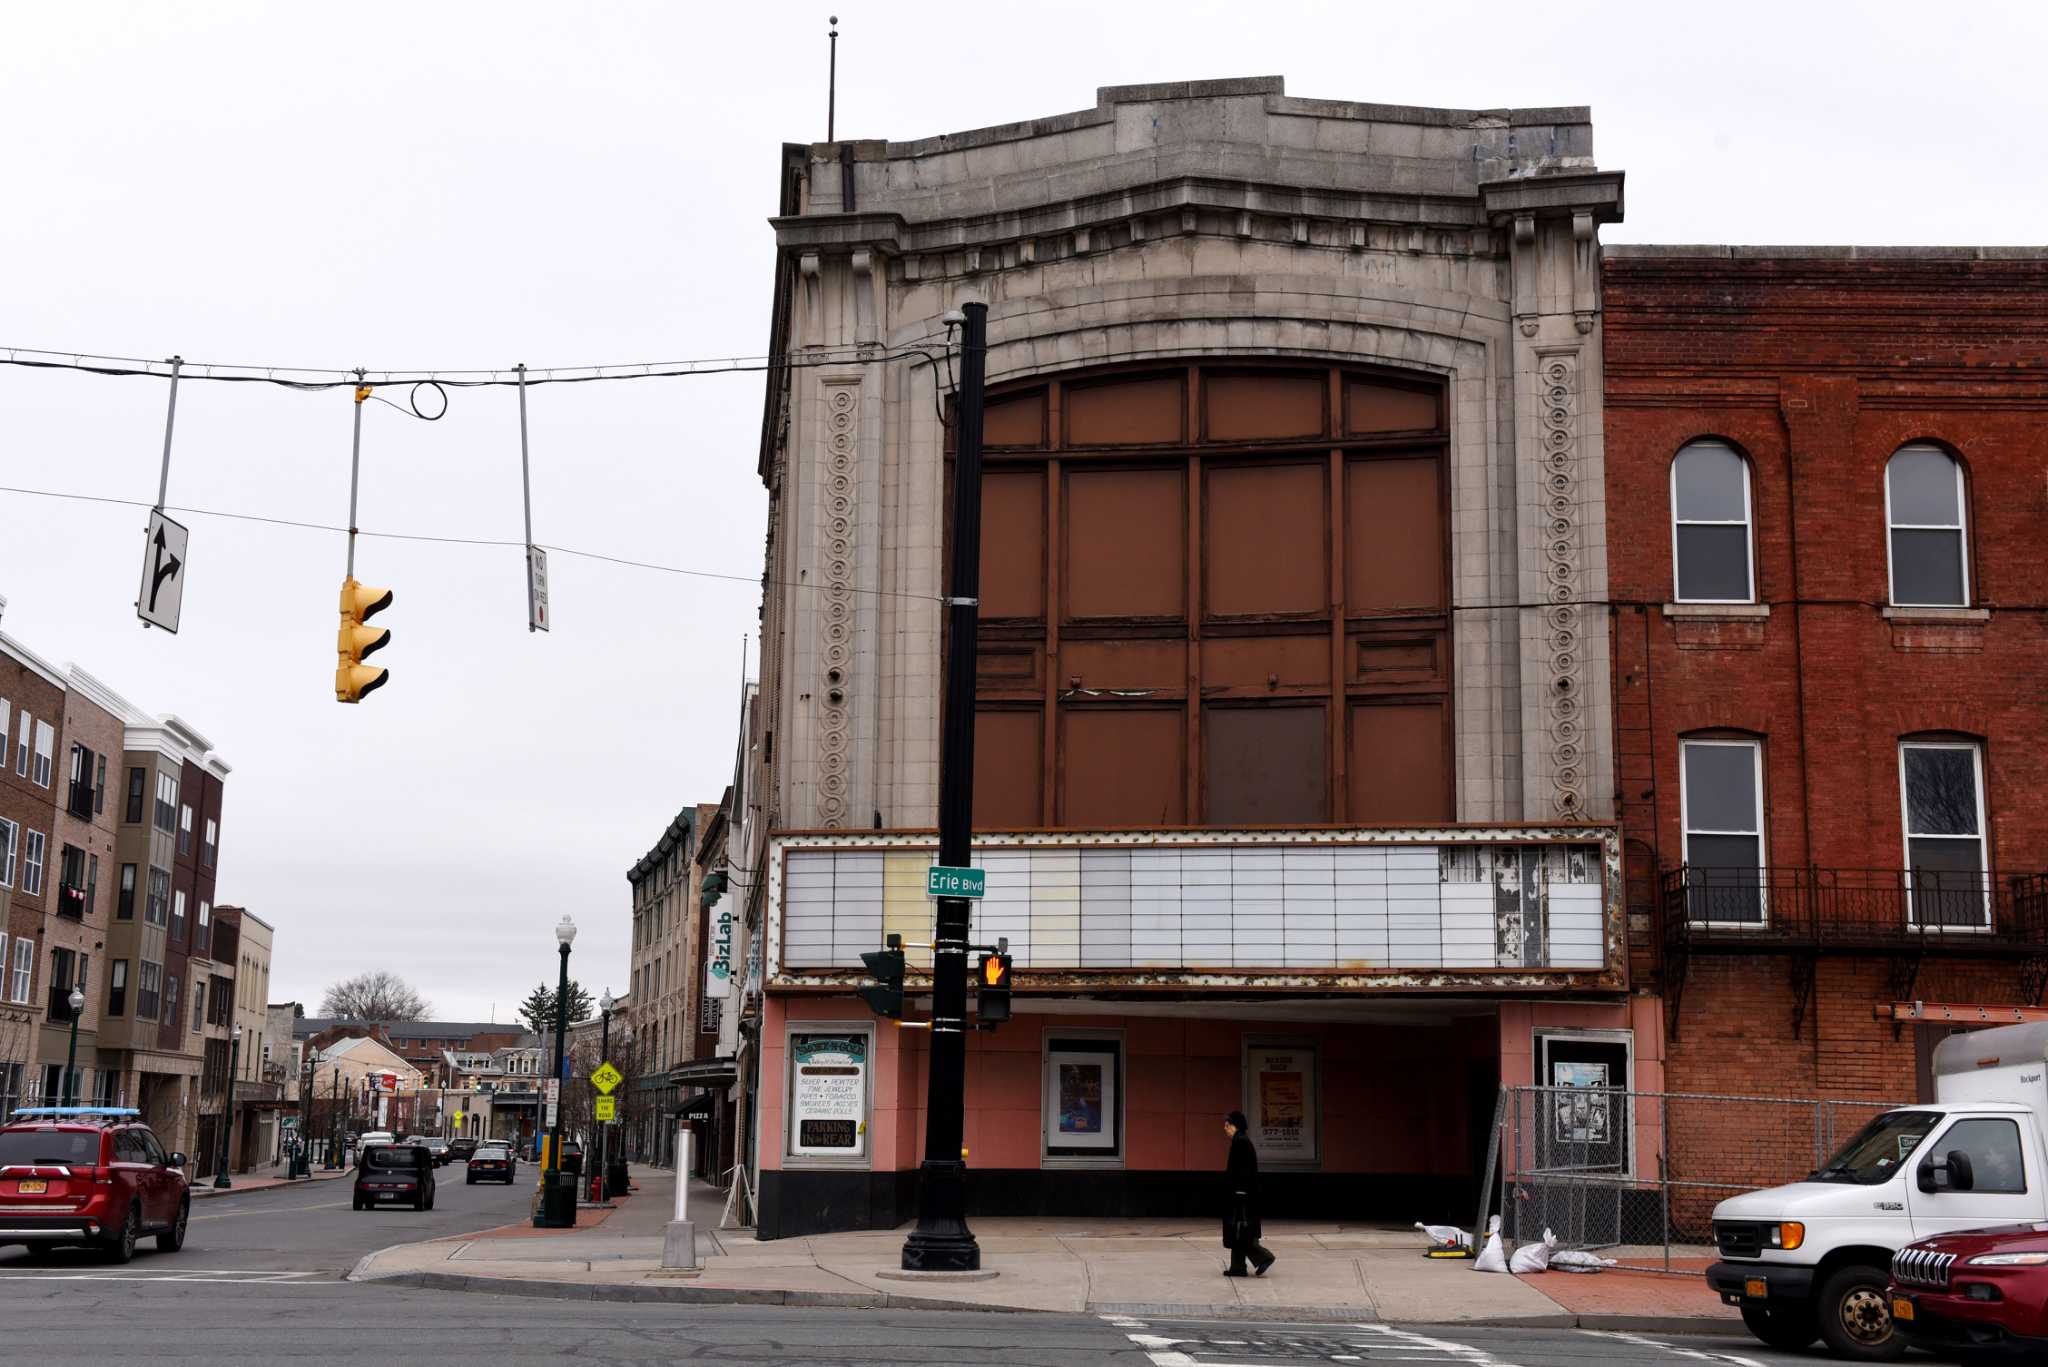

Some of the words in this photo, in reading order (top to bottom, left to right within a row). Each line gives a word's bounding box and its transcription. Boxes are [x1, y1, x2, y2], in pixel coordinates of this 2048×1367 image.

[535, 553, 544, 571] NO
[930, 872, 960, 890] Erie
[962, 879, 983, 891] Blvd
[712, 912, 732, 979] BizLab
[807, 1121, 850, 1133] PARKING
[803, 1134, 814, 1145] IN
[824, 1134, 852, 1145] REAR
